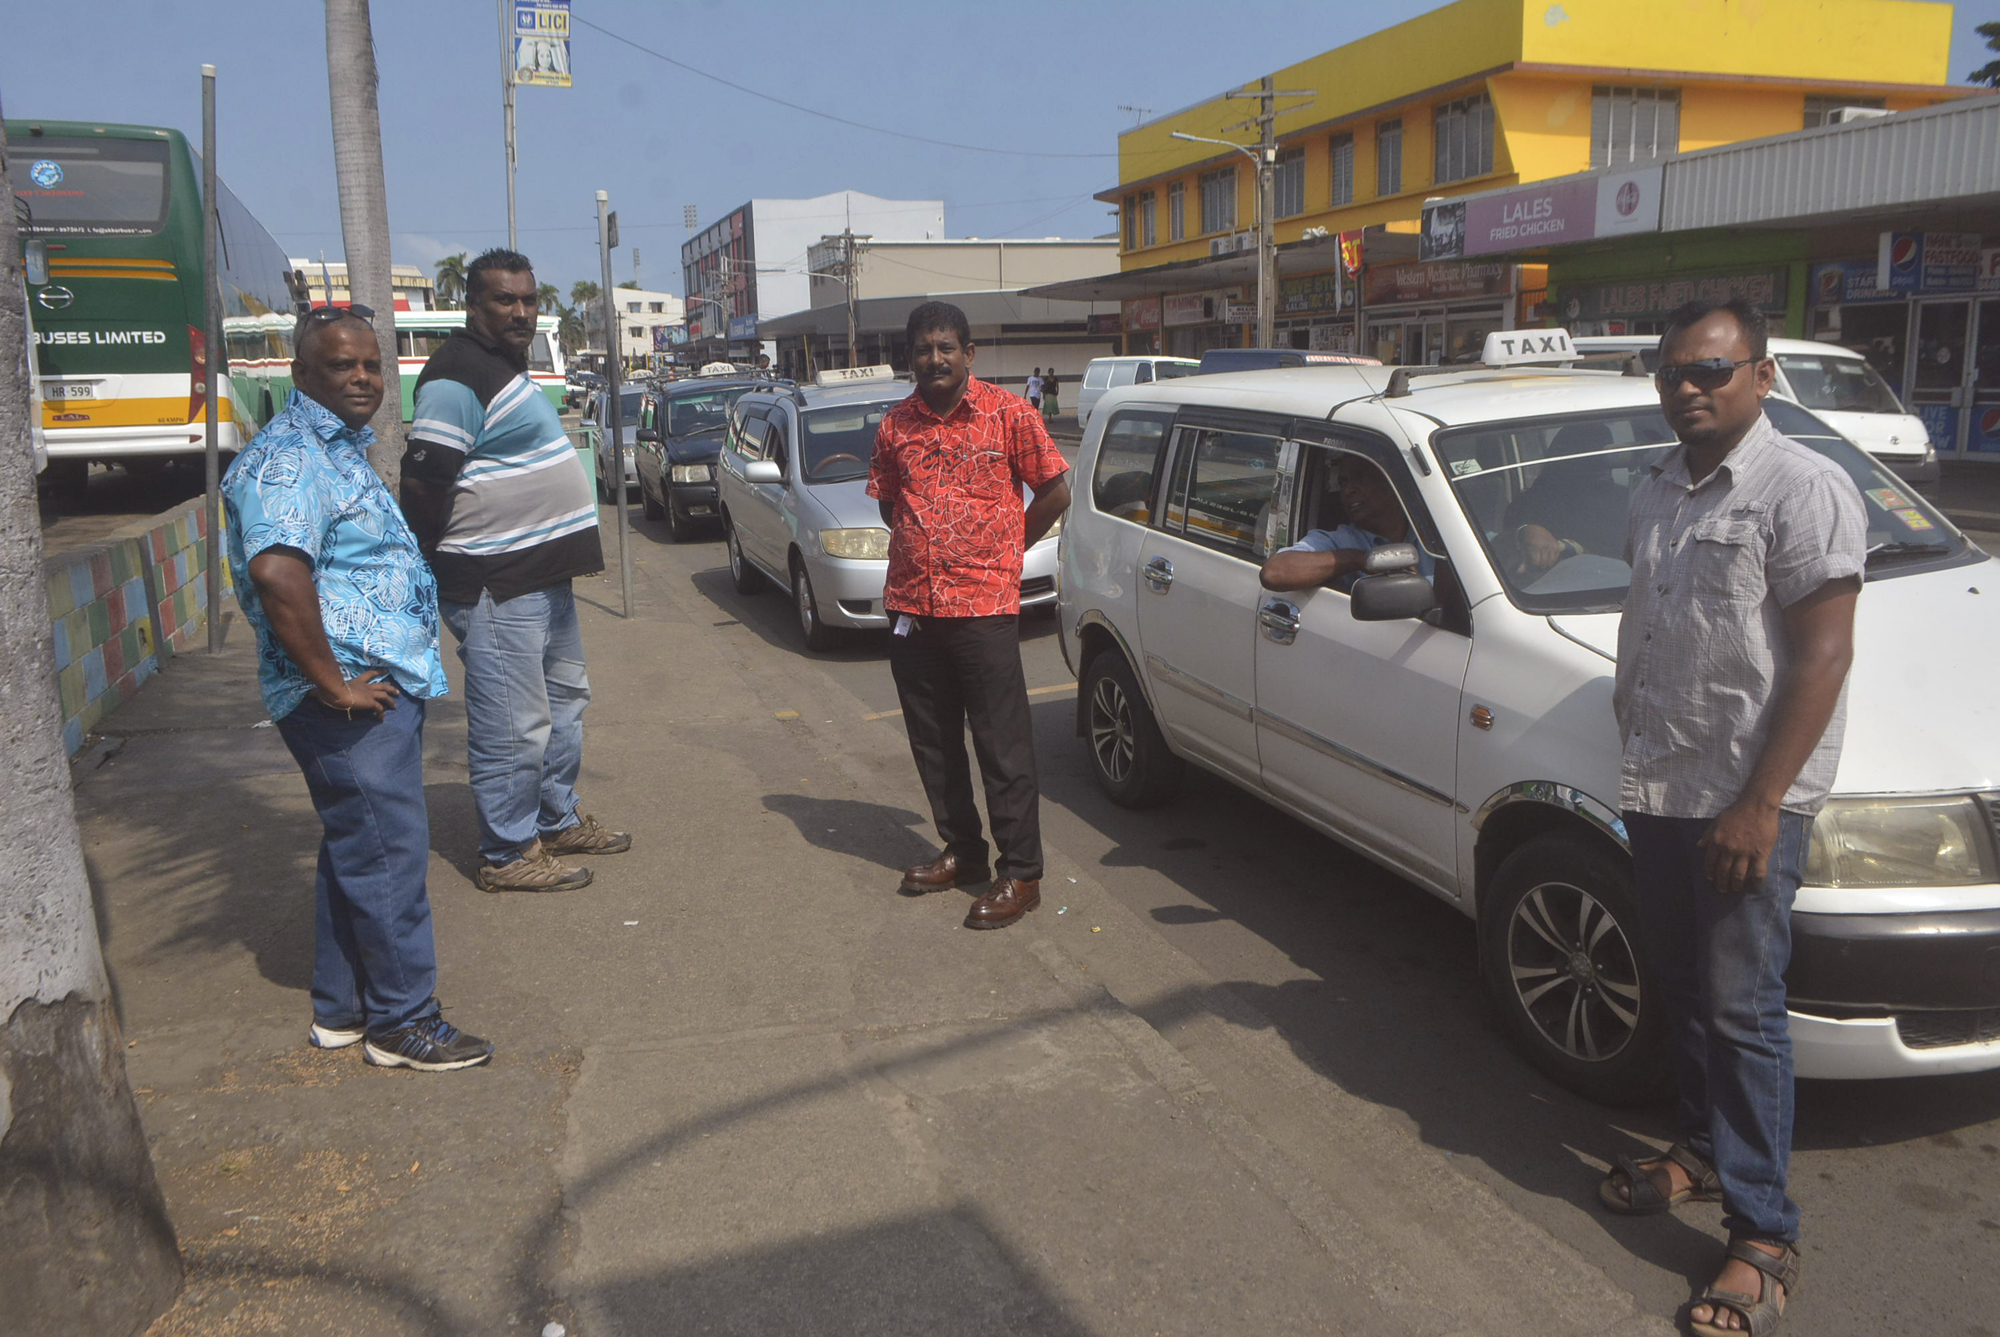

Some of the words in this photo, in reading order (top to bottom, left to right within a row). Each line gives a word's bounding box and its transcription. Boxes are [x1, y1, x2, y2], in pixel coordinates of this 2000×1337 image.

[538, 12, 568, 30] LICI
[1502, 196, 1553, 224] LALES
[1490, 225, 1518, 241] FRIED
[1519, 218, 1565, 237] CHICKEN
[1396, 269, 1424, 287] Western
[1426, 263, 1460, 287] Medicare
[1461, 262, 1503, 280] Pharmacy
[1600, 284, 1647, 314] LALES
[1649, 280, 1695, 312] FRIED
[1699, 273, 1775, 305] CHICKEN
[1285, 301, 1309, 312] SALON
[95, 331, 167, 345] LIMITED
[1501, 336, 1567, 356] TAXI
[706, 364, 731, 375] TAXI
[839, 367, 875, 380] TAXI
[52, 386, 65, 398] HR
[71, 386, 91, 397] 599
[1922, 405, 1948, 420] IVE
